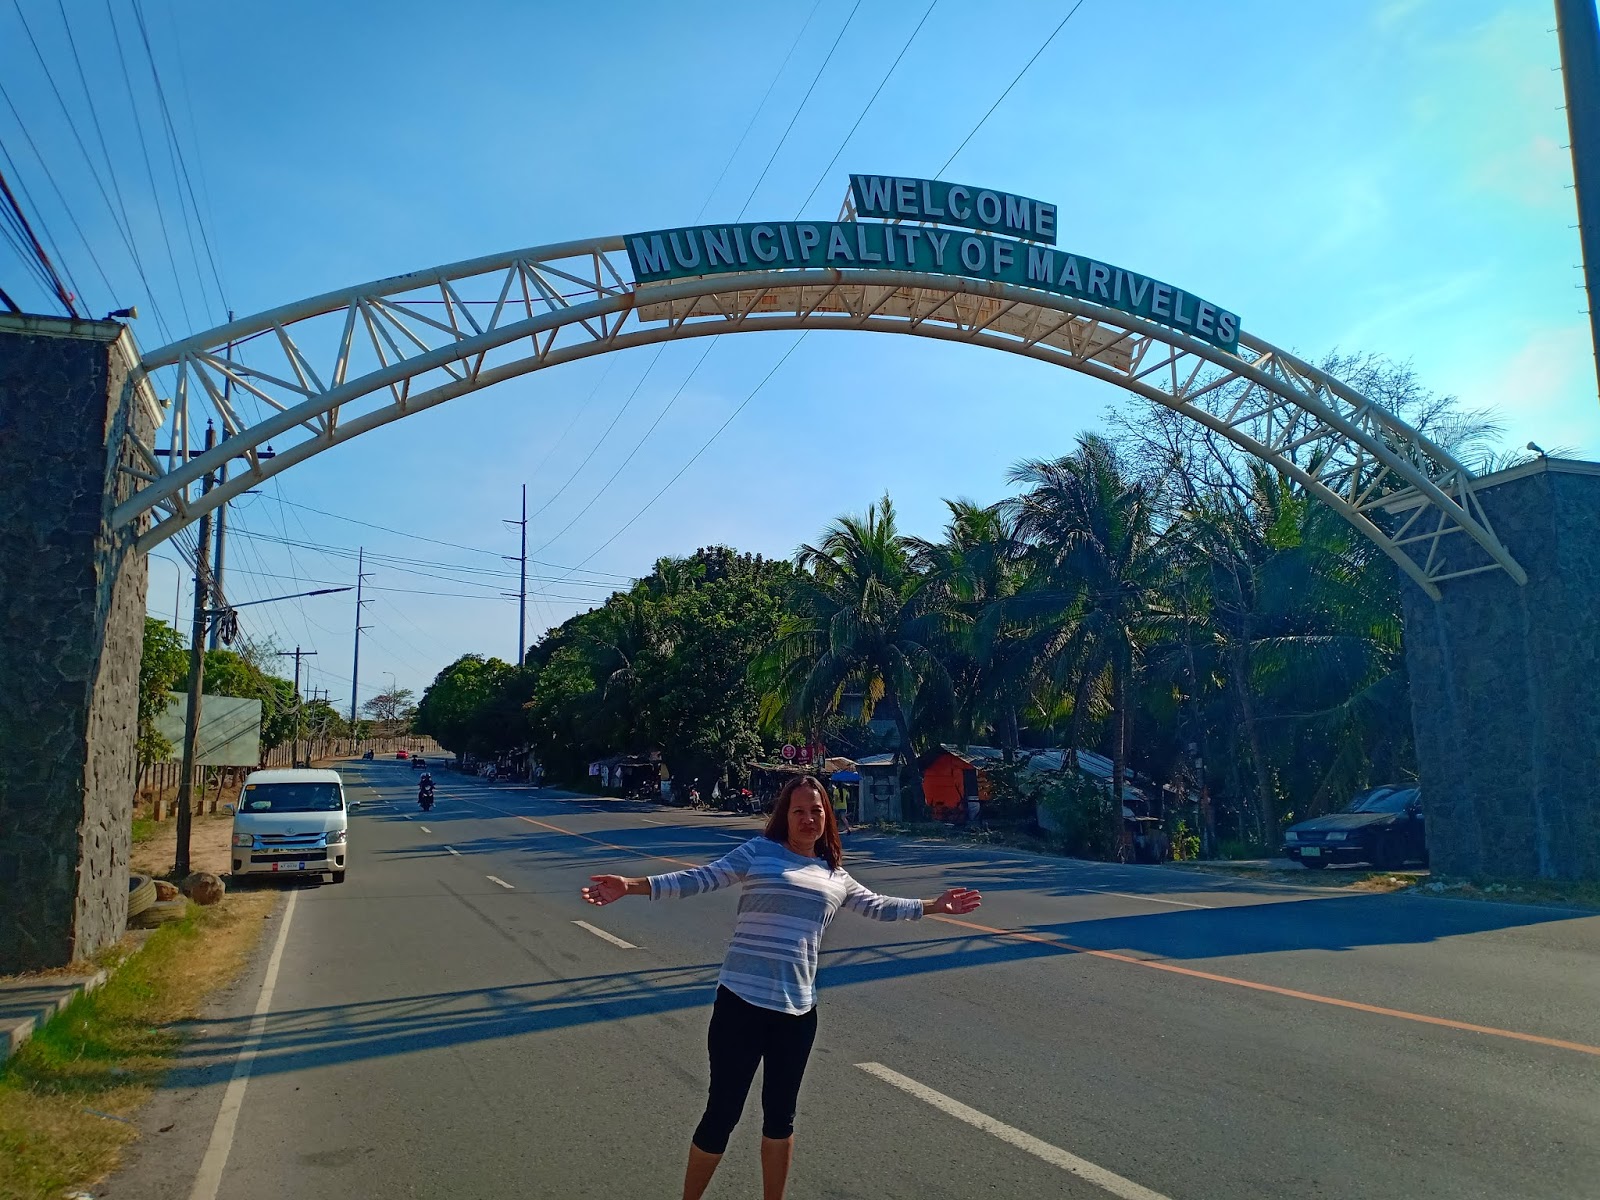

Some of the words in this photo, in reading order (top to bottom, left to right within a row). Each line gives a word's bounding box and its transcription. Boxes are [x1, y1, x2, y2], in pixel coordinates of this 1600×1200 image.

[857, 175, 1055, 237] WELCOME
[631, 224, 950, 275] MUNICIPALITY
[961, 236, 1014, 274] OF
[1028, 246, 1237, 344] MARIVELES
